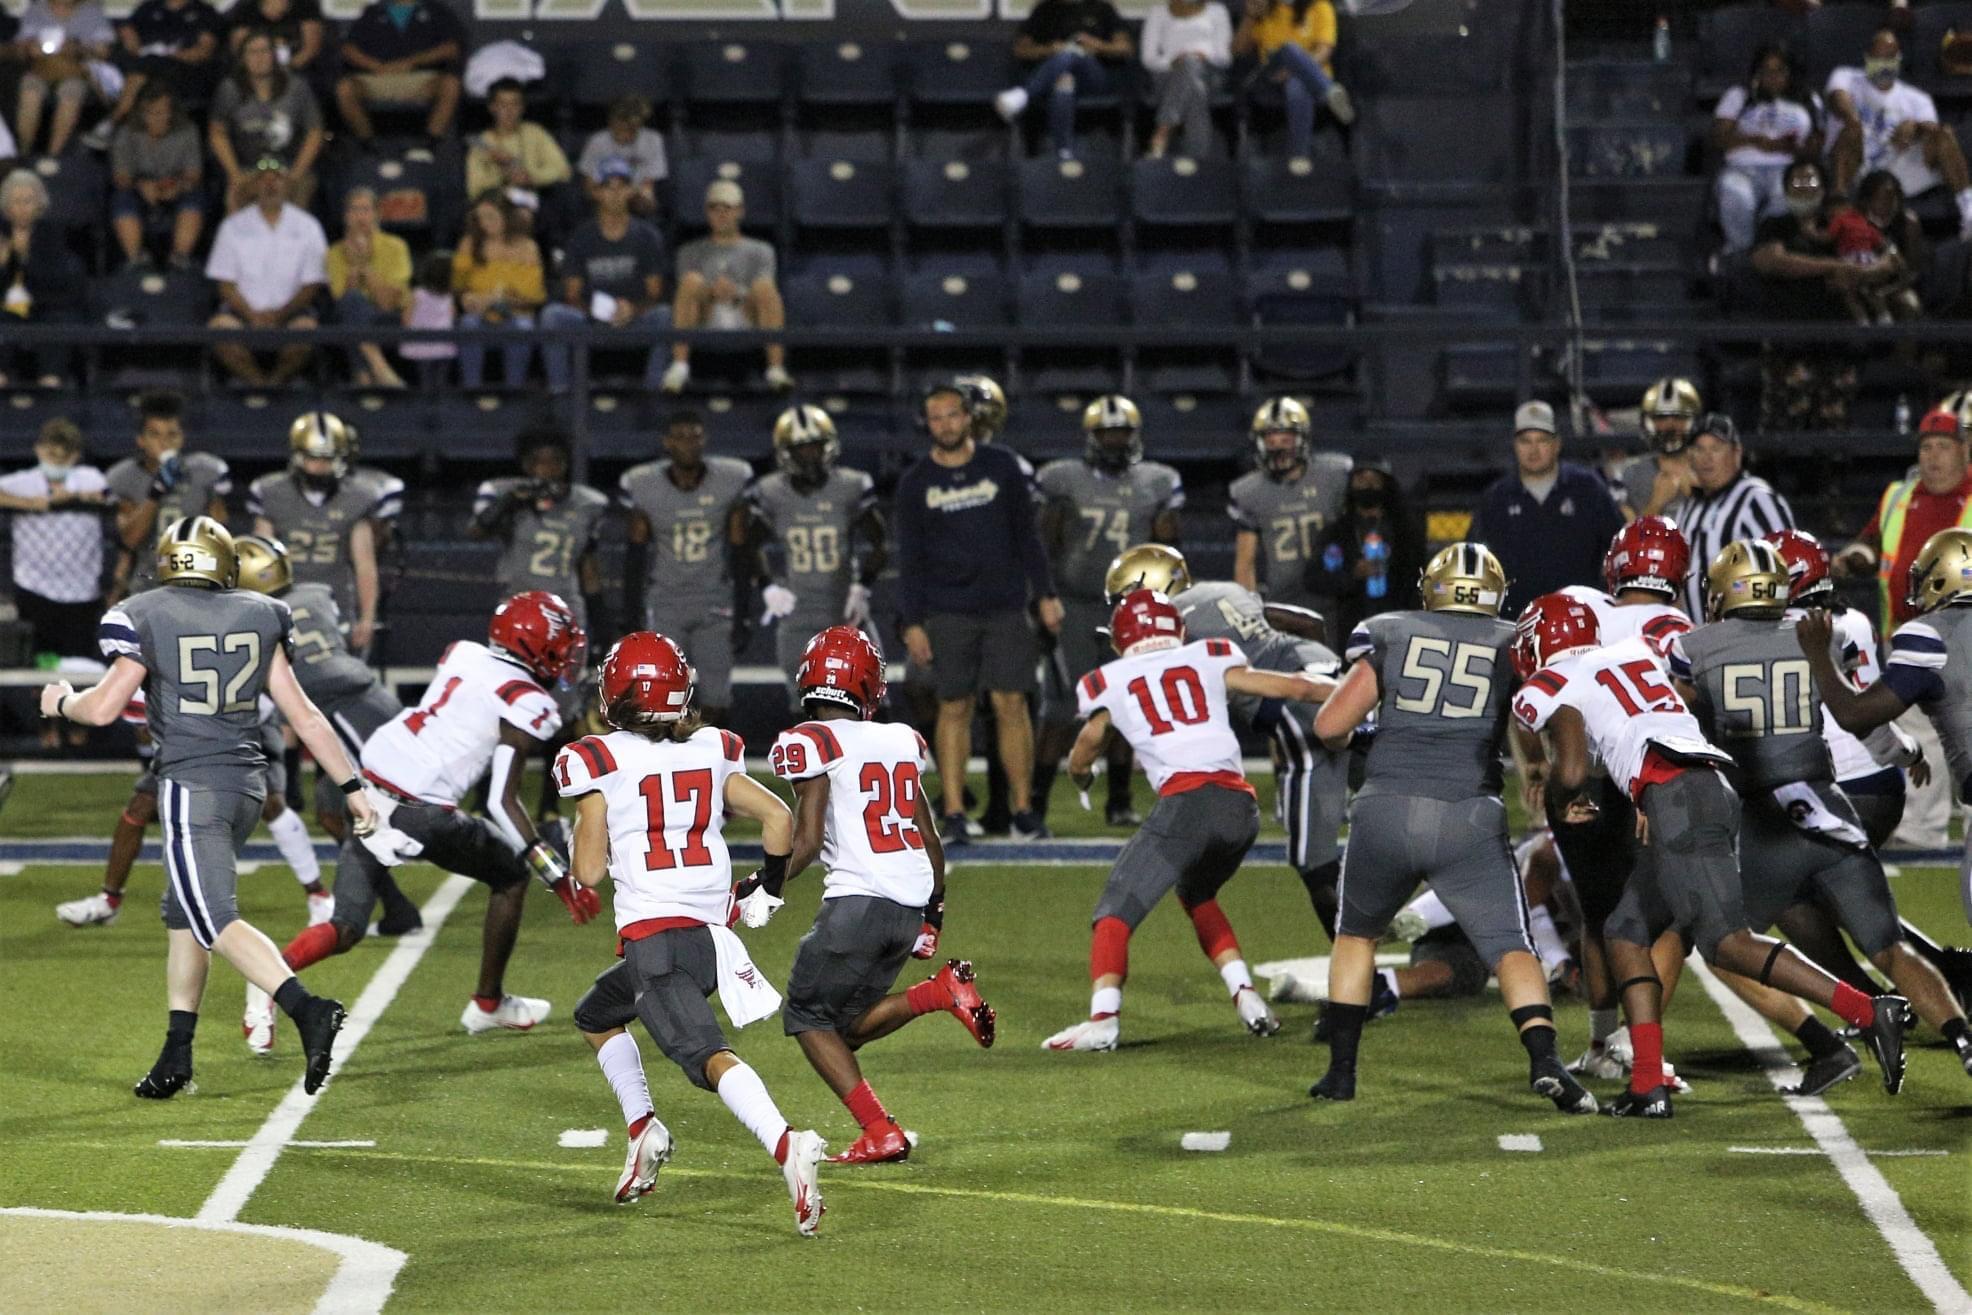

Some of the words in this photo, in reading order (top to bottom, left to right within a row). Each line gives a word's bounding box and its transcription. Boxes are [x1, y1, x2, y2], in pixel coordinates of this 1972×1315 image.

[529, 531, 576, 577] 21
[673, 519, 712, 562] 18
[787, 526, 840, 573] 80
[1080, 507, 1130, 553] 74
[178, 631, 260, 715] 52
[642, 681, 651, 692] 17
[1127, 665, 1210, 736] 10
[1395, 635, 1497, 718] 55
[1595, 658, 1685, 717] 15
[1723, 659, 1812, 737] 50
[403, 676, 463, 736] 1
[772, 743, 807, 776] 29
[638, 768, 714, 872] 17
[859, 761, 926, 854] 29
